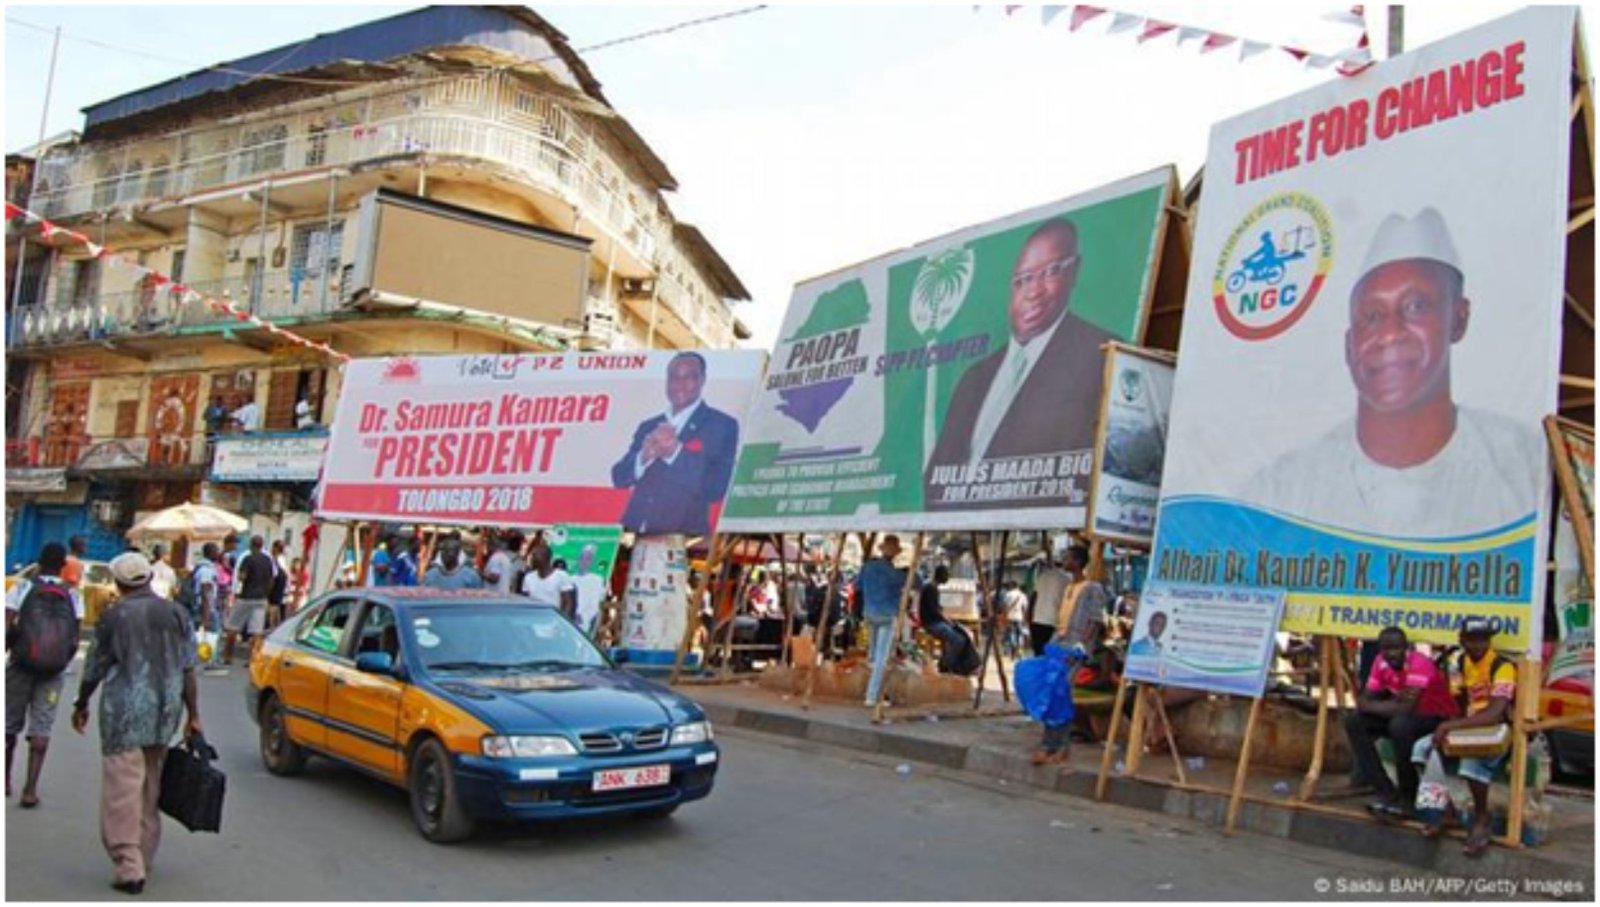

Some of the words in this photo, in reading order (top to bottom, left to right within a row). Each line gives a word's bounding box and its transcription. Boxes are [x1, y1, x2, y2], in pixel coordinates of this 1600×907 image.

[1234, 119, 1304, 185] TIME
[1306, 98, 1369, 162] FOR
[1373, 40, 1526, 140] CHANGE
[1238, 284, 1297, 315] NGC
[578, 355, 647, 370] UNION
[785, 327, 861, 369] PAOPA
[359, 402, 389, 433] Dr.
[394, 399, 492, 431] Samura
[497, 393, 610, 426] Kamara
[374, 427, 563, 478] PRESIDENT
[930, 463, 989, 486] JULIUS
[990, 457, 1054, 482] MAADA
[398, 487, 485, 513] TOLONGBO
[486, 486, 533, 512] 2018
[942, 484, 968, 502] FOR
[968, 479, 1039, 501] PRESIDENT
[1039, 478, 1075, 498] 2018
[1159, 548, 1219, 583] Alhaji
[1257, 551, 1346, 589] Kandeh
[1354, 553, 1376, 590] K.
[1386, 553, 1521, 598] Yumkella
[1330, 604, 1520, 635] TRANSFORMAON
